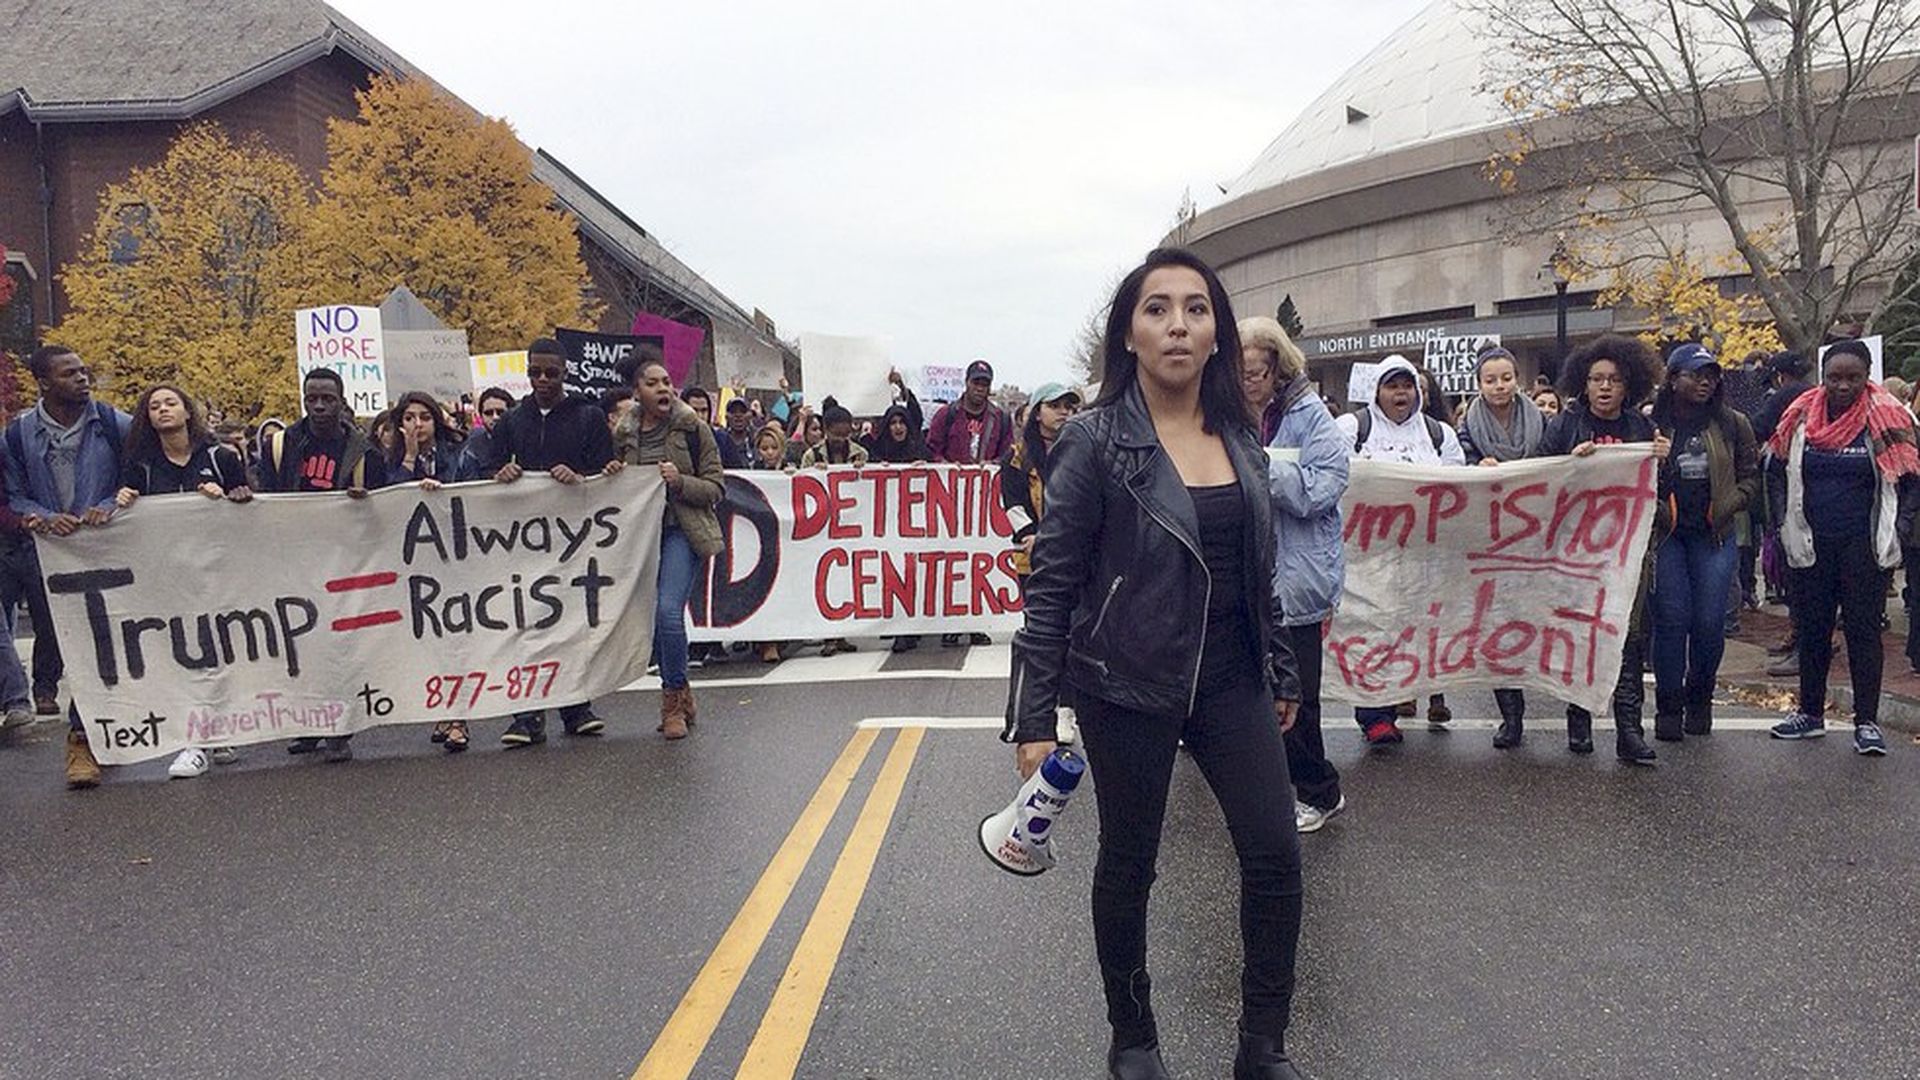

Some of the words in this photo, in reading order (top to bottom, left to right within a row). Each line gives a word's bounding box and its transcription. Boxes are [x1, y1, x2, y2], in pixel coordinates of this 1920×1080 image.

[311, 306, 358, 337] NO
[308, 336, 376, 359] MORE
[1319, 337, 1362, 353] NORTH
[1369, 327, 1446, 349] ENTRANCE
[1427, 337, 1477, 356] BLACK
[301, 361, 382, 381] VTIM
[1427, 354, 1477, 373] LIVES
[354, 391, 382, 411] ME
[403, 496, 622, 564] Always
[815, 547, 1025, 621] CENTERS
[47, 568, 319, 688] Trump
[409, 556, 615, 639] Racist
[95, 711, 166, 750] Text
[186, 692, 345, 742] NeverTrump
[358, 684, 394, 717] to
[425, 661, 561, 710] 877-877
